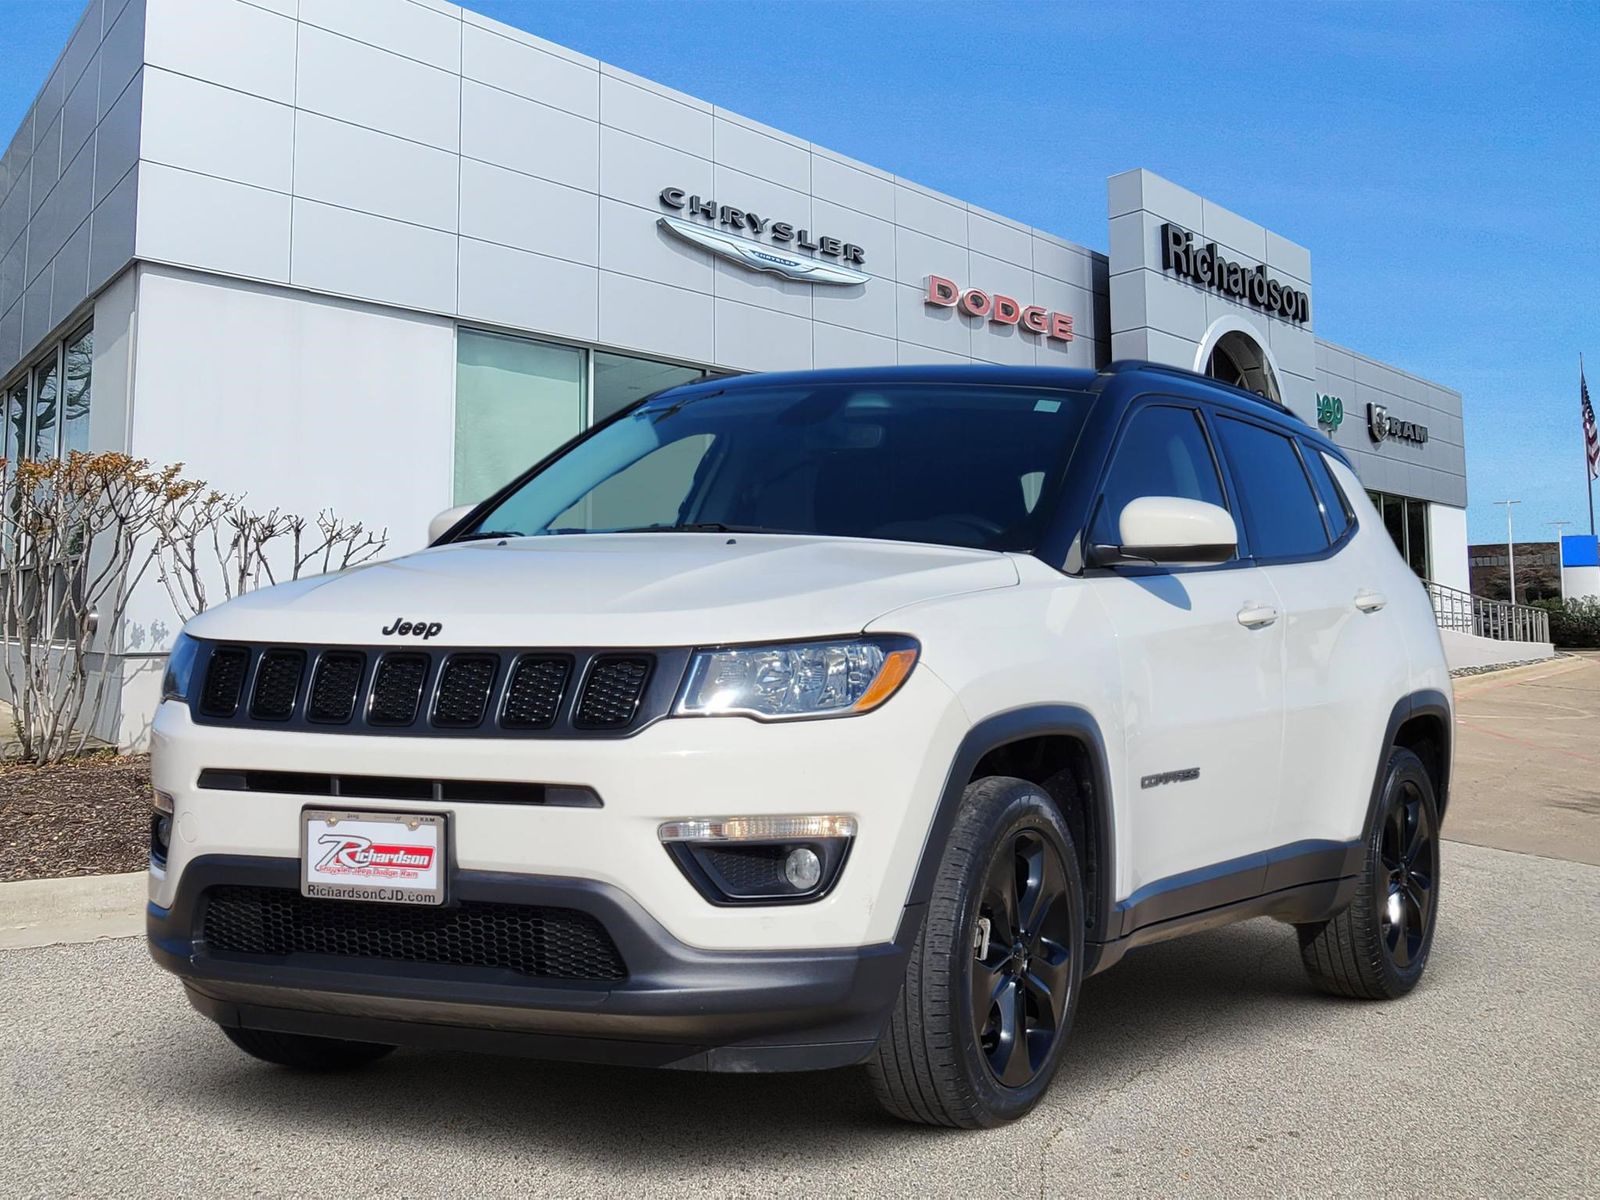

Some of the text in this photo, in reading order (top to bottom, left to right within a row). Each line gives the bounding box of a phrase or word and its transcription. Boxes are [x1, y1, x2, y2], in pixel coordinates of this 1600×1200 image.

[659, 187, 866, 264] CHRYSLER
[1161, 223, 1309, 323] Richardson
[923, 274, 1074, 342] DODGE
[1386, 416, 1428, 443] RAM
[382, 617, 443, 640] Jeep
[1141, 767, 1201, 789] COMPASS
[315, 834, 430, 871] Richardson
[307, 885, 436, 903] RichardsonCJD.com
